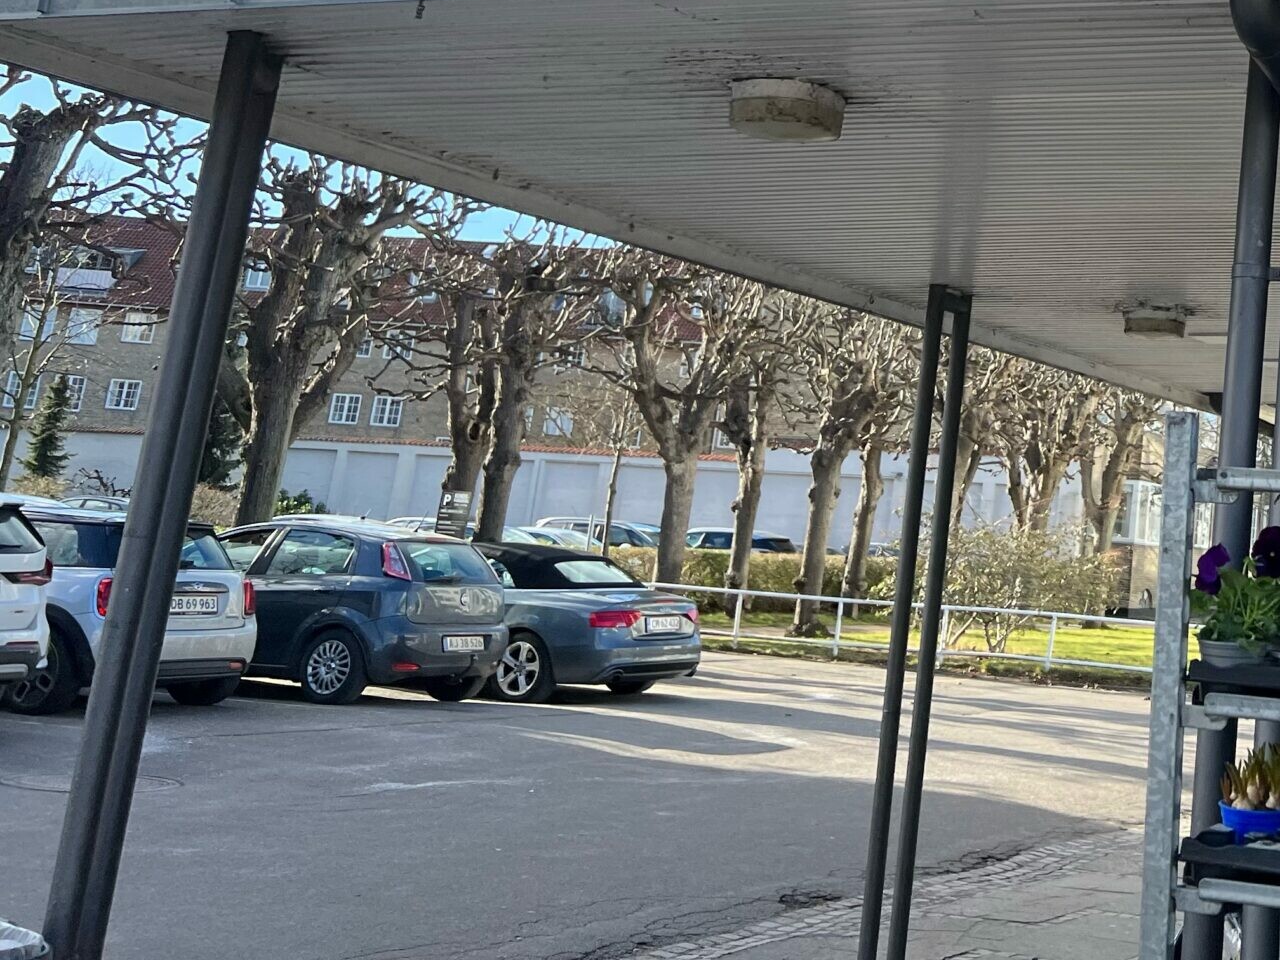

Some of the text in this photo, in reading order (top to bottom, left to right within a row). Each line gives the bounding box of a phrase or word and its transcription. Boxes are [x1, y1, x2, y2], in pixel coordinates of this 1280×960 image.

[443, 494, 452, 506] P
[185, 598, 197, 610] 69
[199, 598, 216, 610] 963
